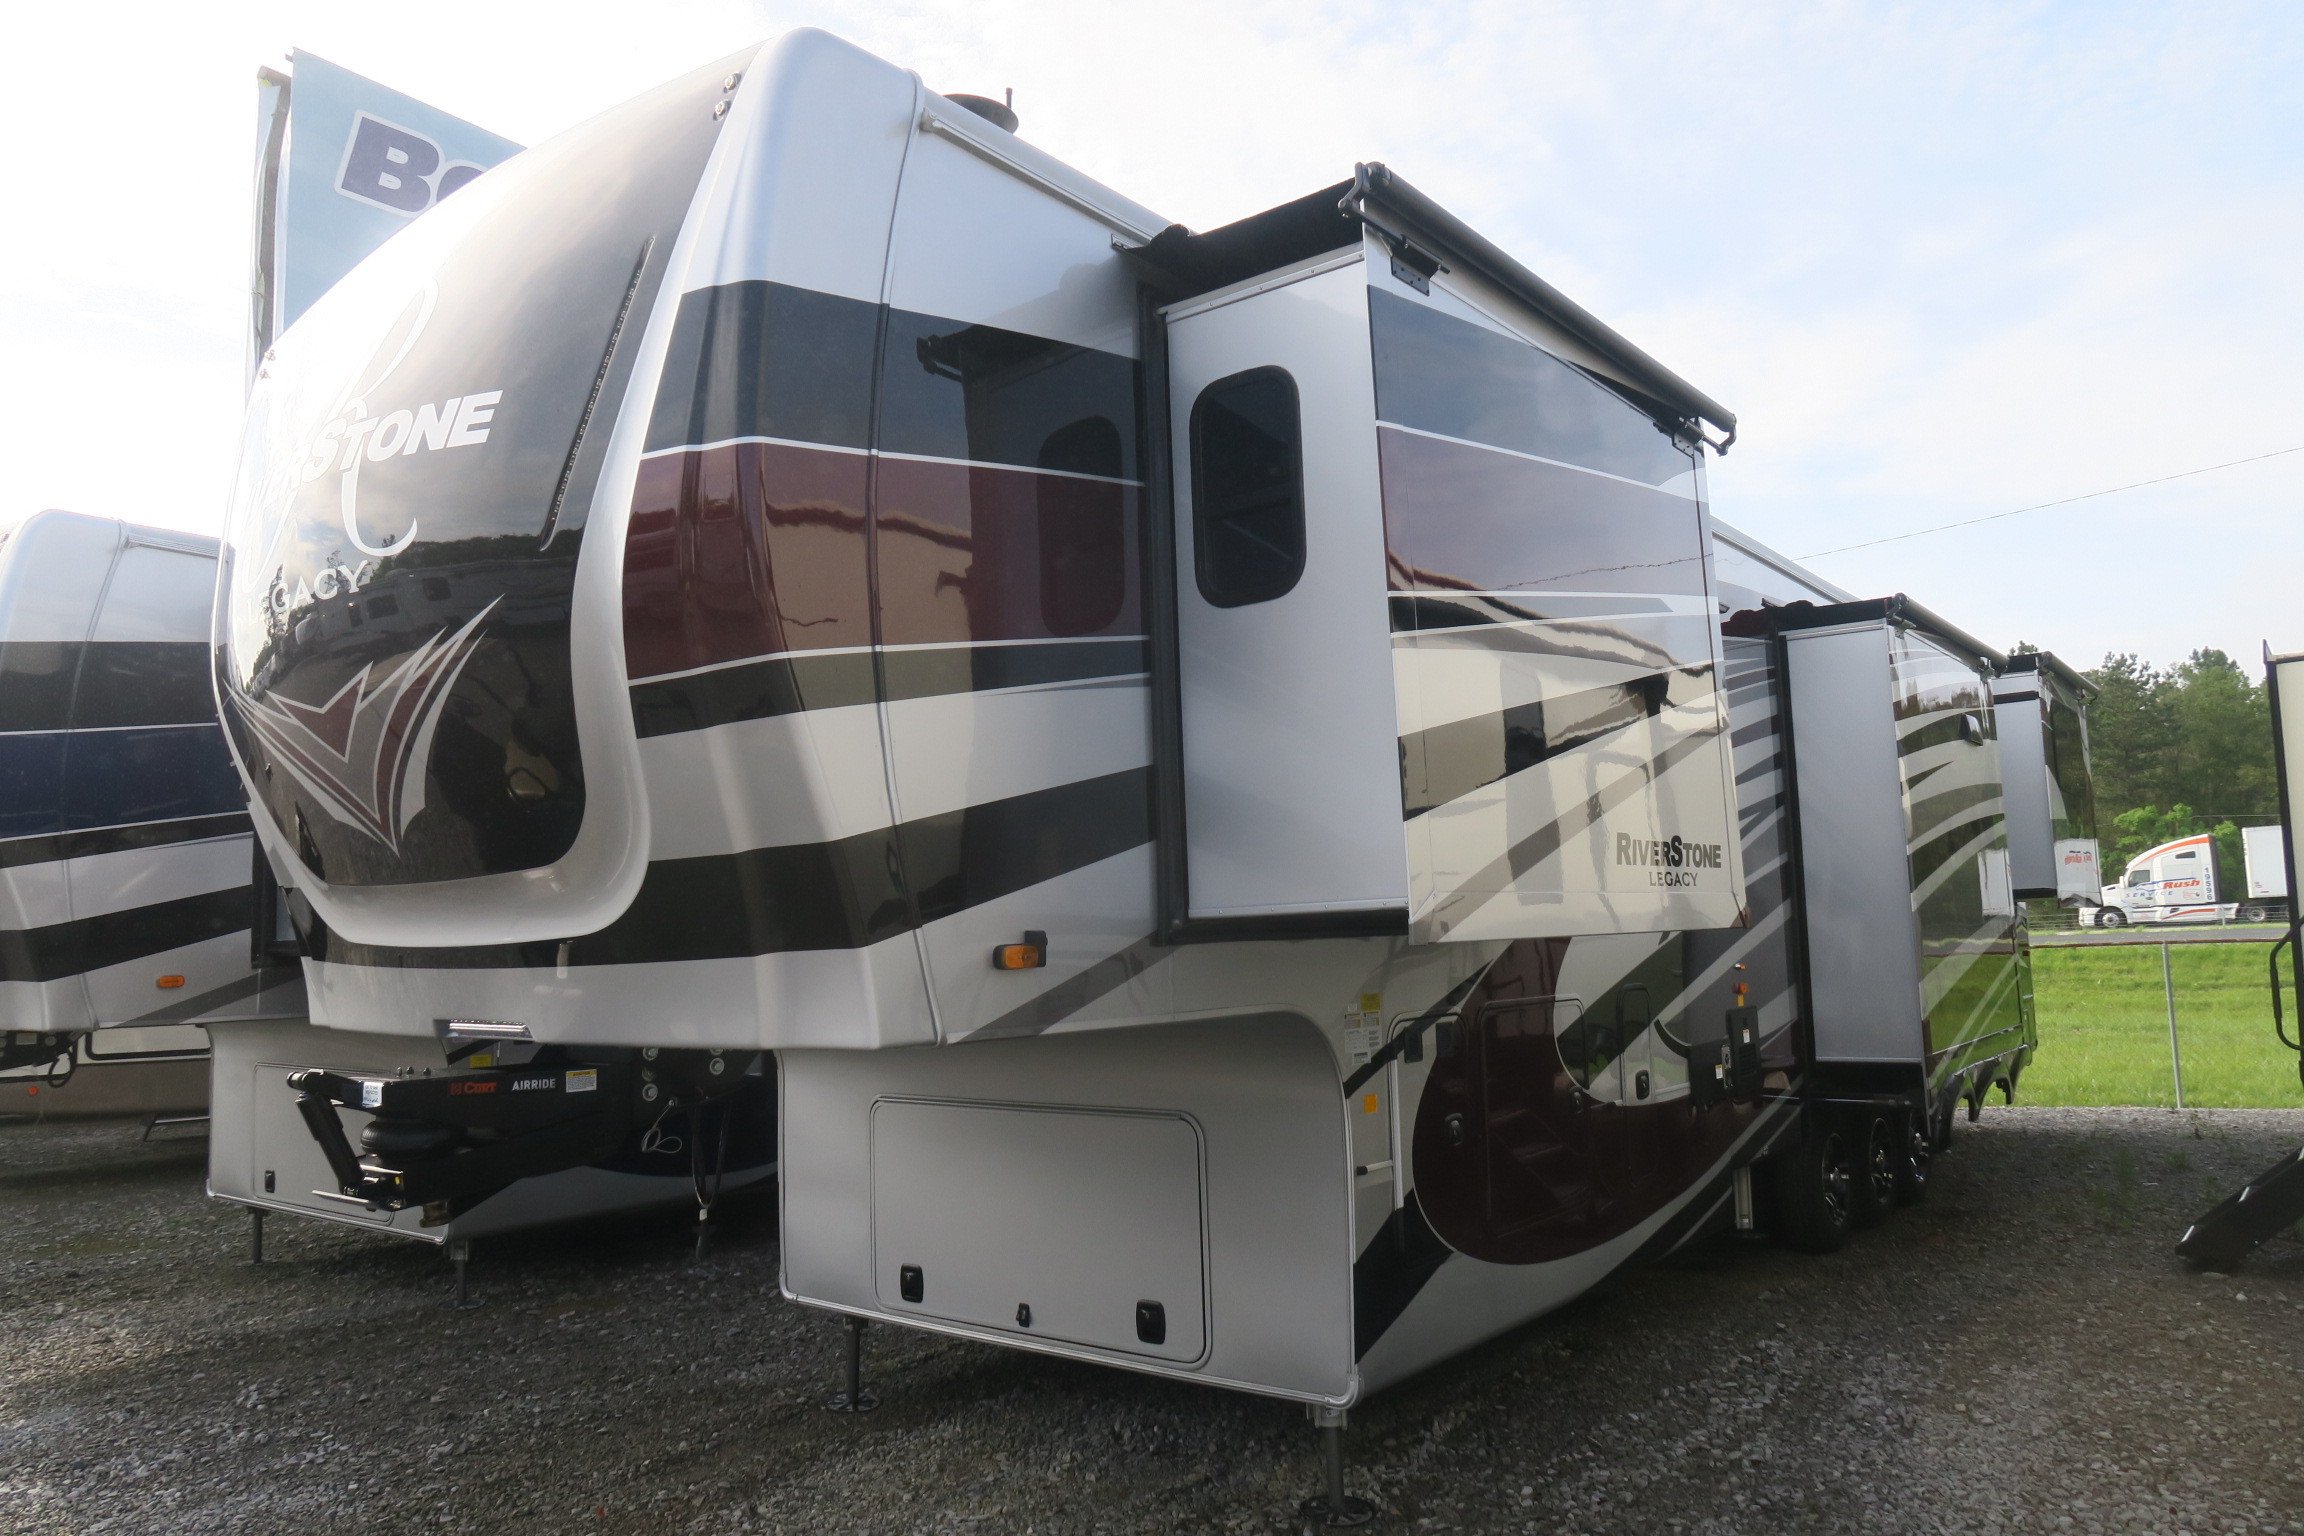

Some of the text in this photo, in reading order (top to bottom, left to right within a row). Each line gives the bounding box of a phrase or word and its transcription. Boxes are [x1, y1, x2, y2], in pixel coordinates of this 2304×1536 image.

[1648, 871, 1698, 887] LEGACY
[2163, 880, 2200, 889] Rush
[2126, 890, 2173, 898] SERVICE
[512, 1078, 557, 1092] AIRRIDE
